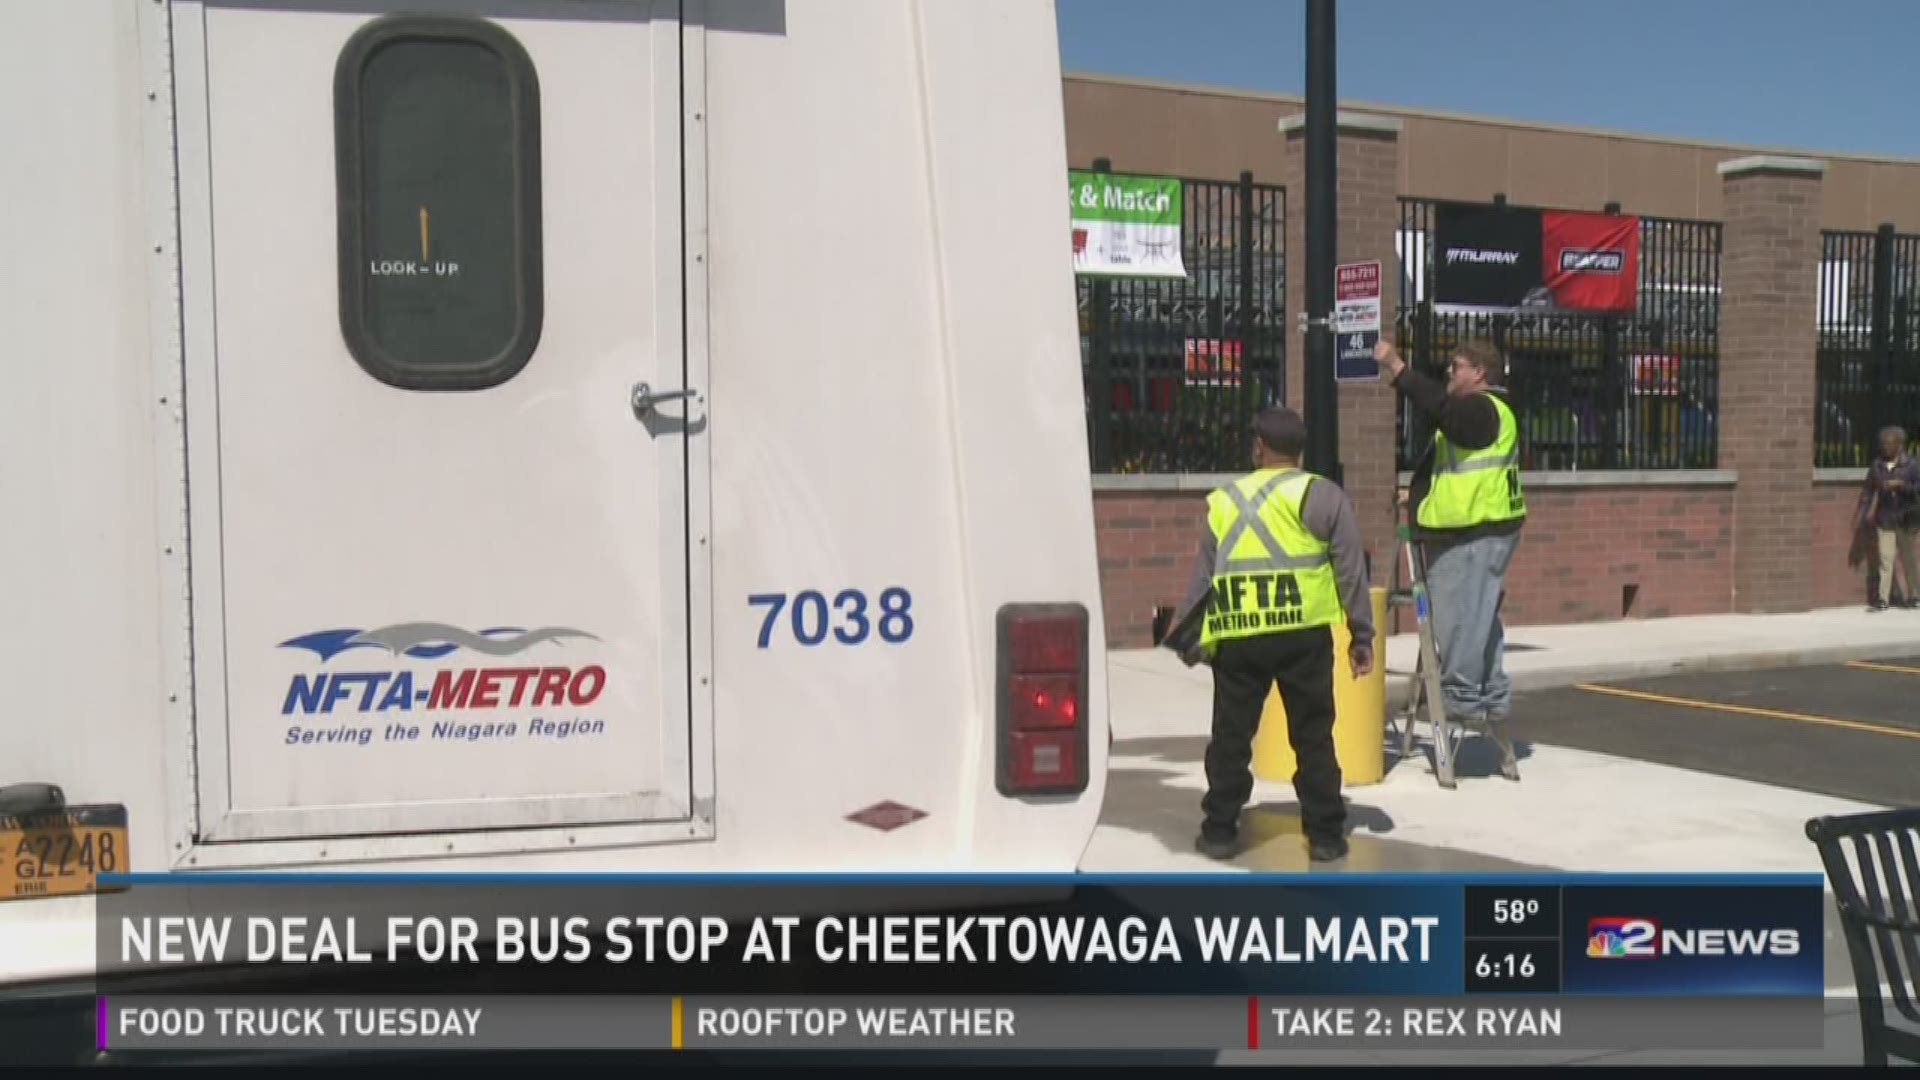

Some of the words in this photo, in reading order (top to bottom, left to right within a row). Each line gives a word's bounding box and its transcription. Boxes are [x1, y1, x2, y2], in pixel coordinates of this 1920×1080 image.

[1080, 184, 1097, 207] &
[1104, 186, 1170, 212] Match
[370, 260, 417, 275] LOOK
[435, 262, 459, 275] UP
[1459, 248, 1520, 265] MURRAY
[1349, 334, 1364, 349] 46
[1206, 574, 1302, 615] NFTA
[747, 587, 914, 649] 7038
[1208, 612, 1260, 634] METRO
[281, 664, 607, 715] NFTA-METRO
[284, 726, 373, 746] Serving
[383, 723, 420, 742] the
[431, 720, 518, 742] Niagara
[528, 716, 605, 737] Region
[36, 831, 115, 878] 2248
